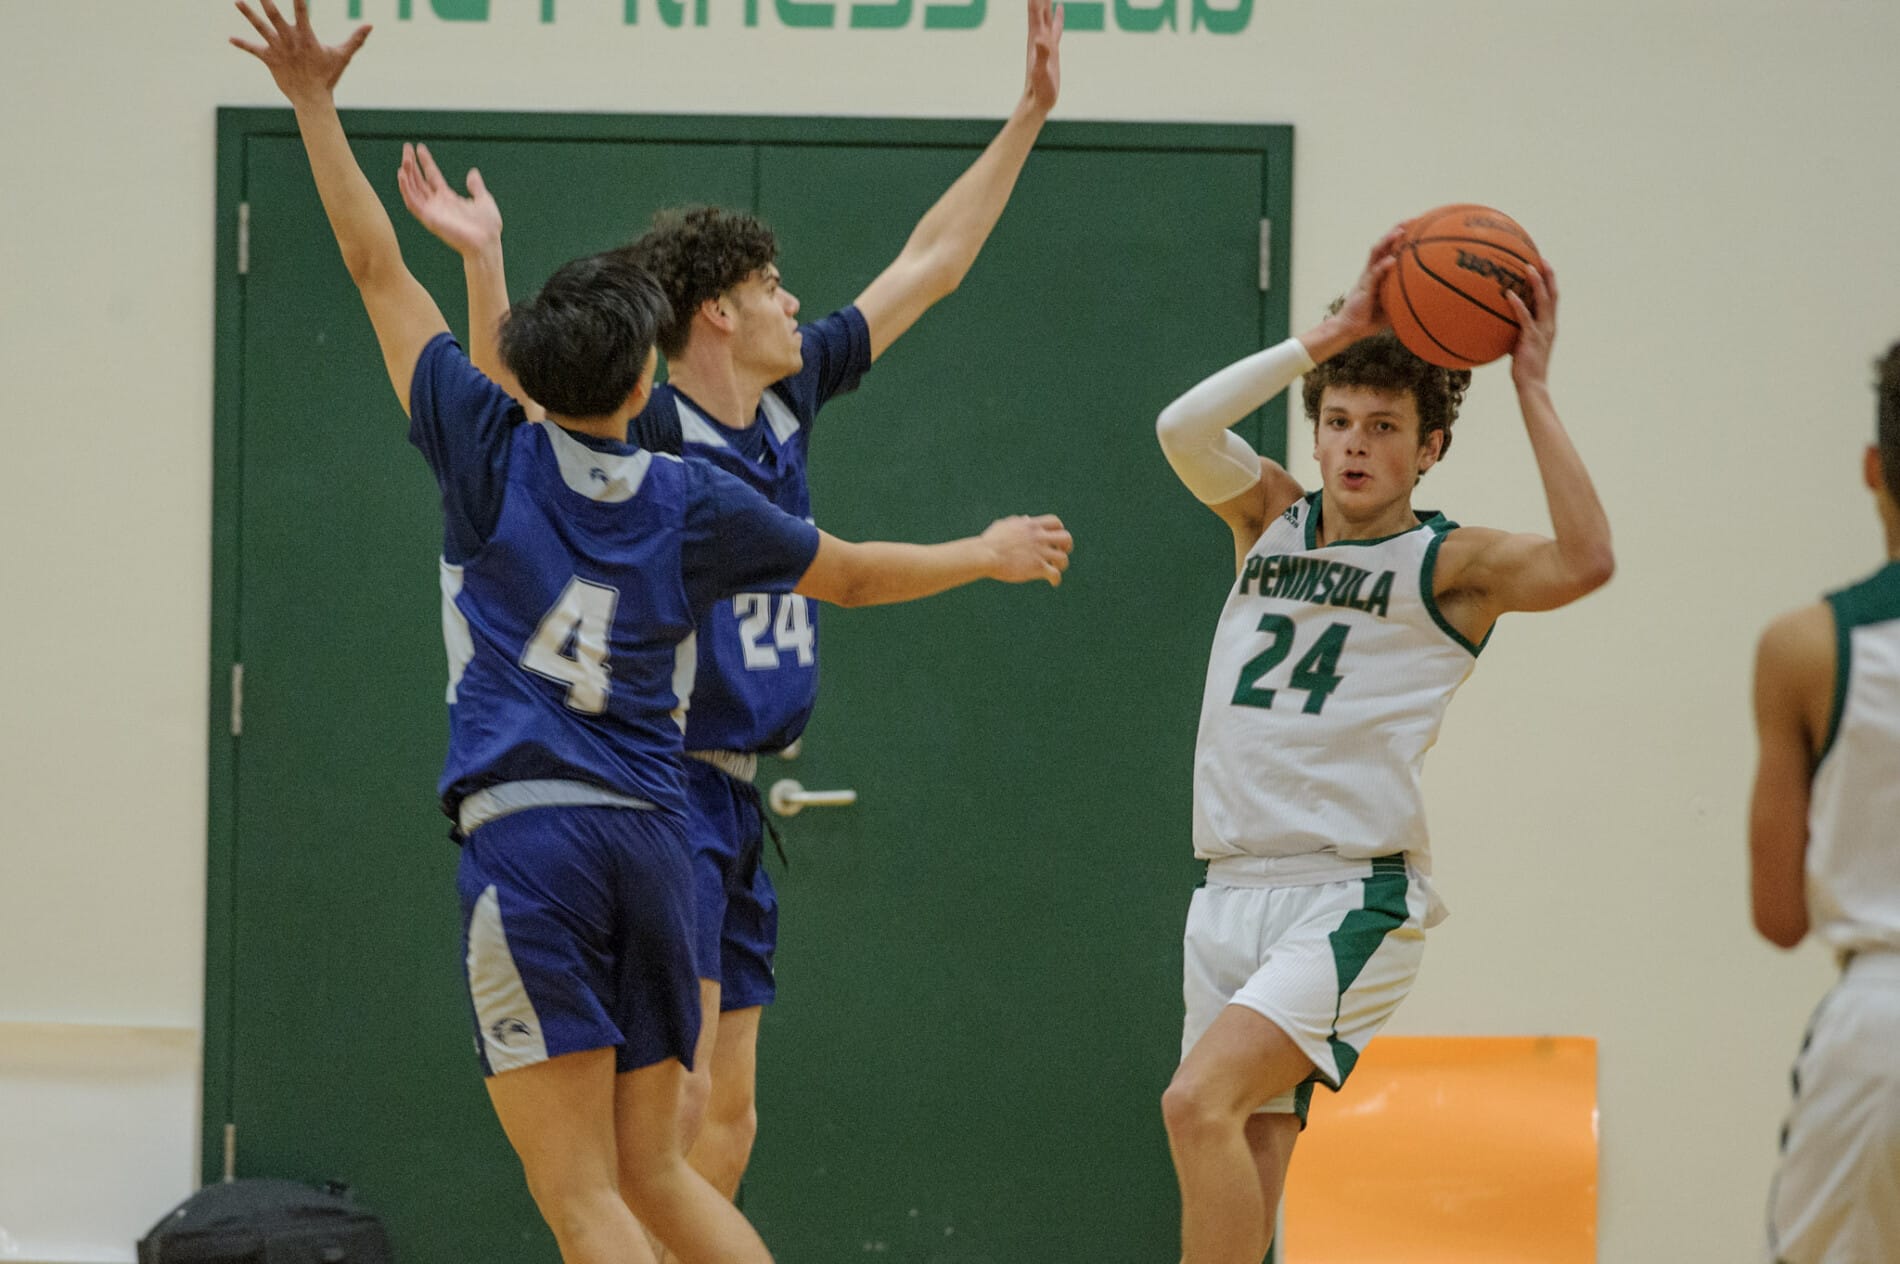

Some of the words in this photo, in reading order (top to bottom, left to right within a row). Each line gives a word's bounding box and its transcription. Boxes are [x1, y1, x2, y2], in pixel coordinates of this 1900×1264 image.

[1238, 553, 1396, 618] PENINSULA
[518, 573, 620, 717] 4
[732, 592, 816, 672] 24
[1230, 612, 1352, 716] 24
